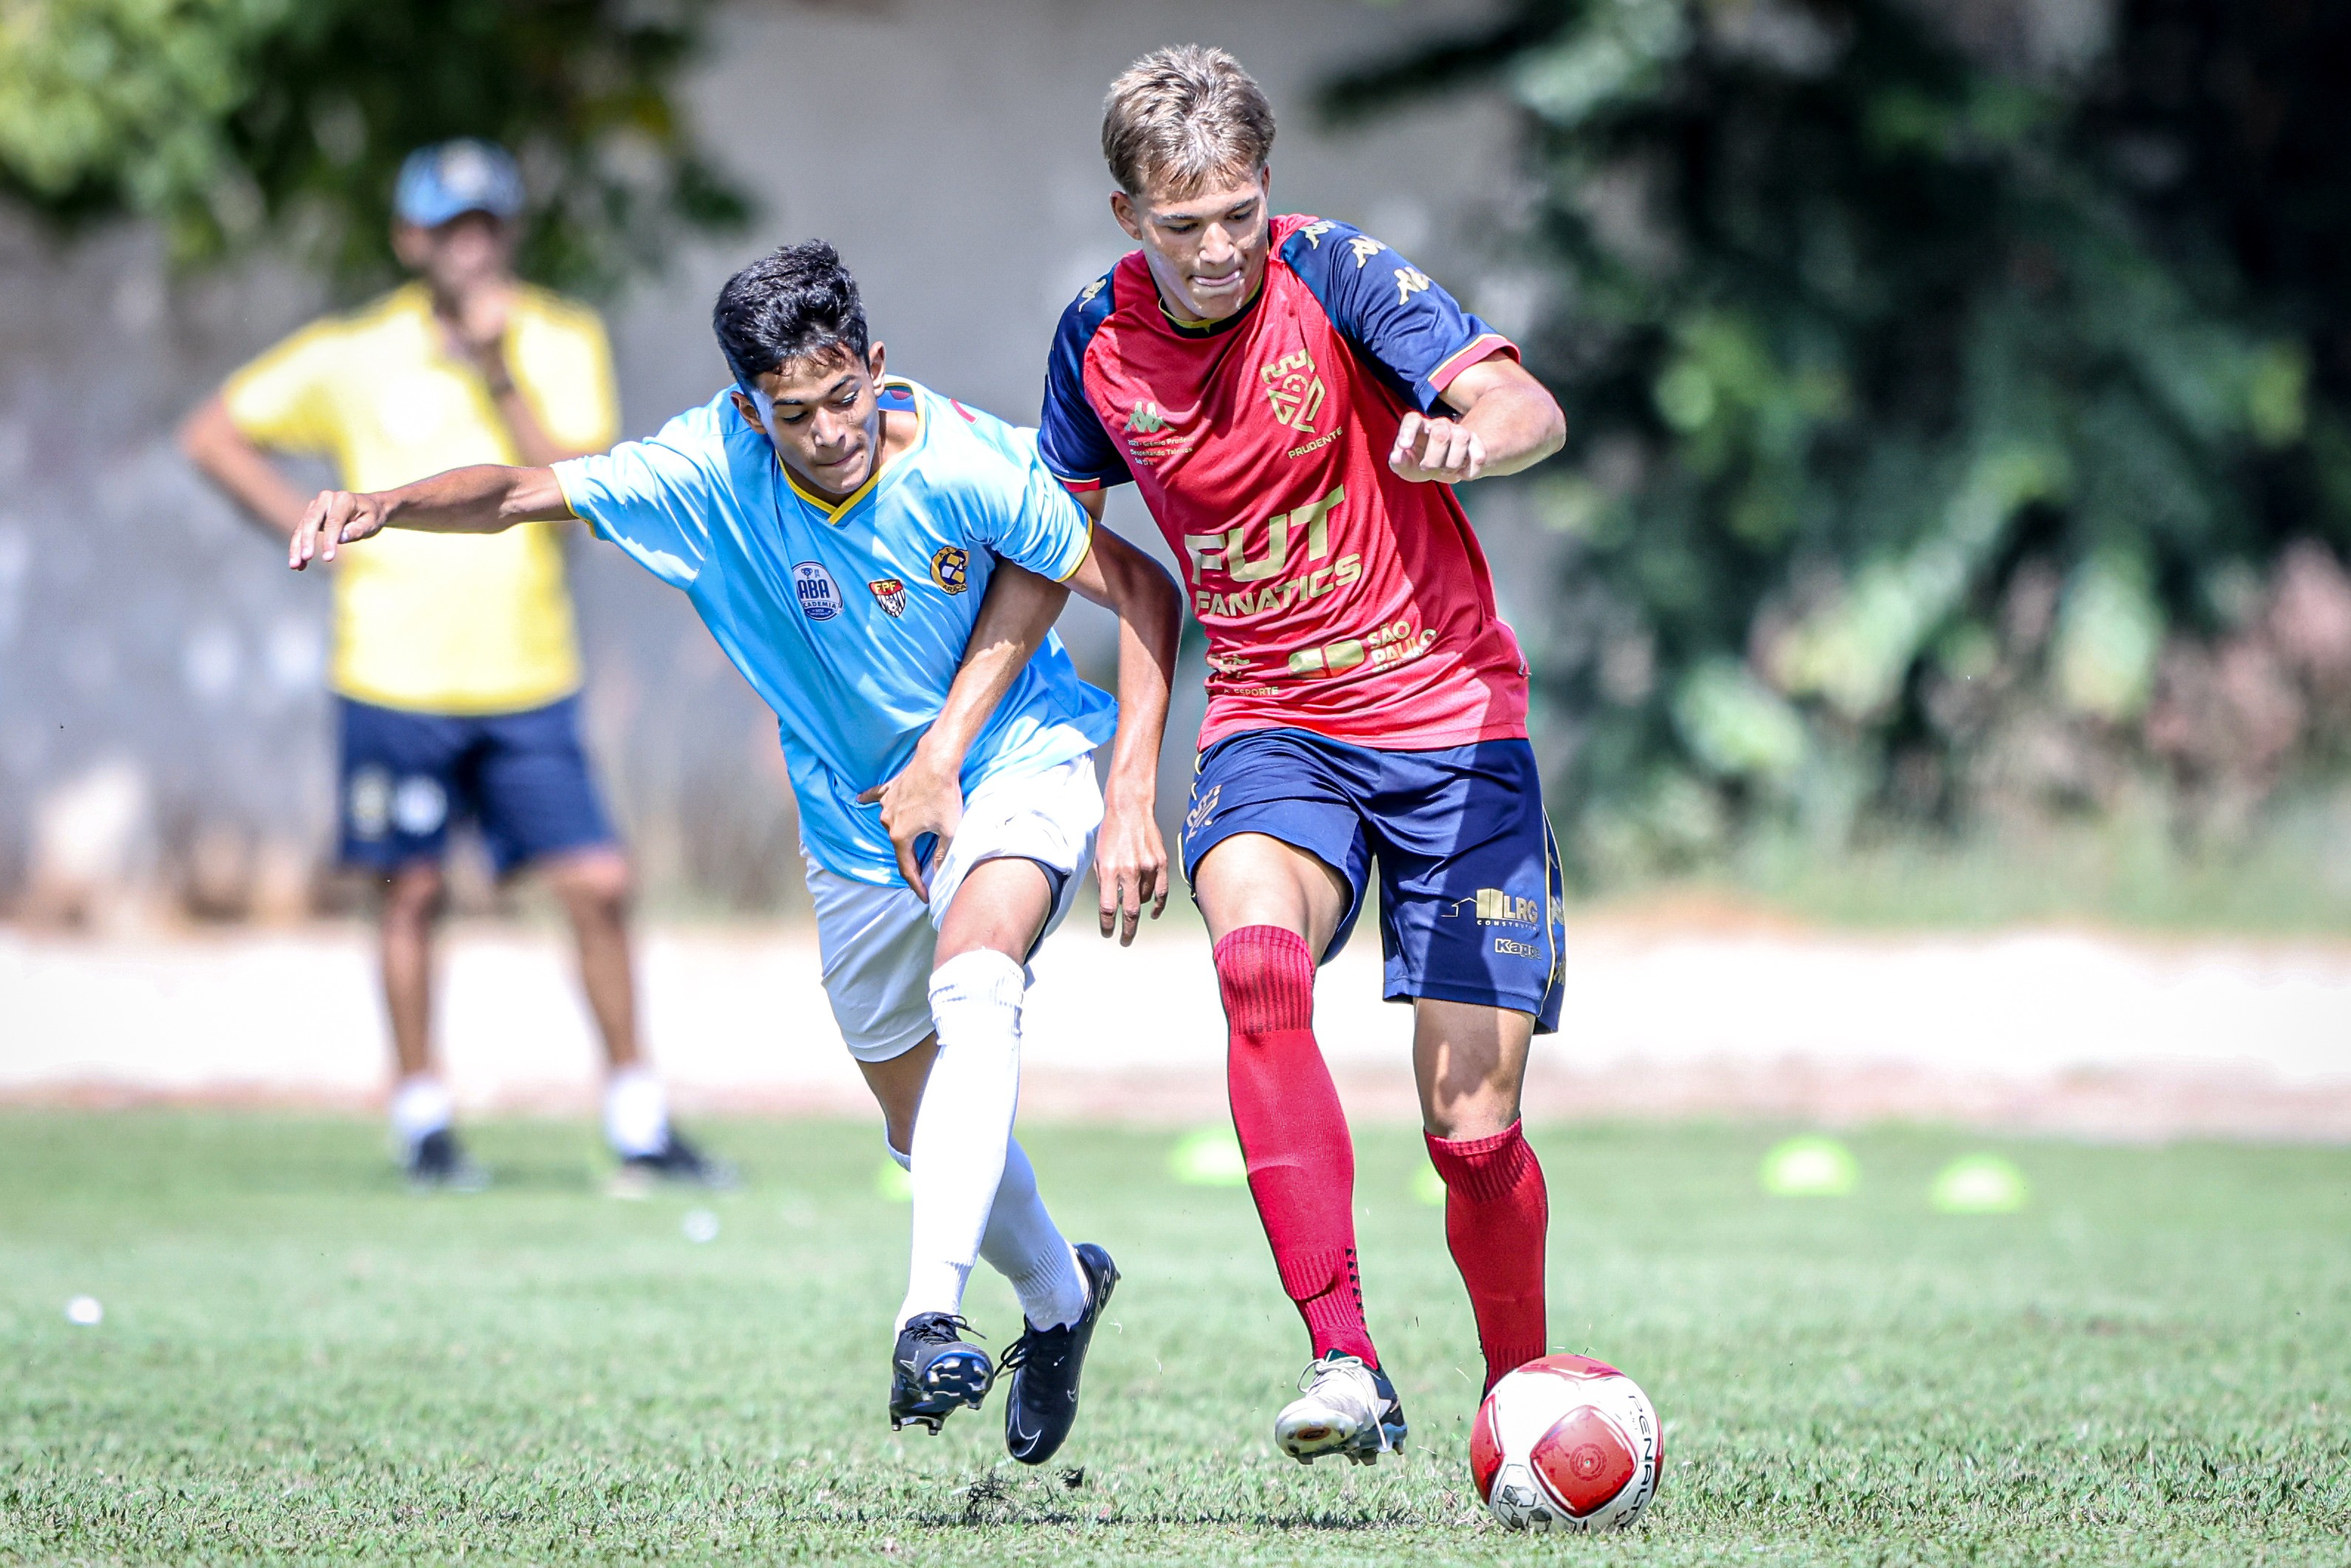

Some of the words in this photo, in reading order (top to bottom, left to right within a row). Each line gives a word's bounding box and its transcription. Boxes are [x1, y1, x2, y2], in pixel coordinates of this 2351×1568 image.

[1288, 427, 1343, 459] PRUDENTE
[1184, 484, 1345, 586] FUT
[797, 579, 831, 600] ABA
[874, 581, 897, 594] FPF
[1195, 553, 1363, 617] FANATICS
[803, 601, 837, 609] CADEMIA
[1367, 622, 1411, 650] SÃO
[1503, 895, 1539, 923] LRG
